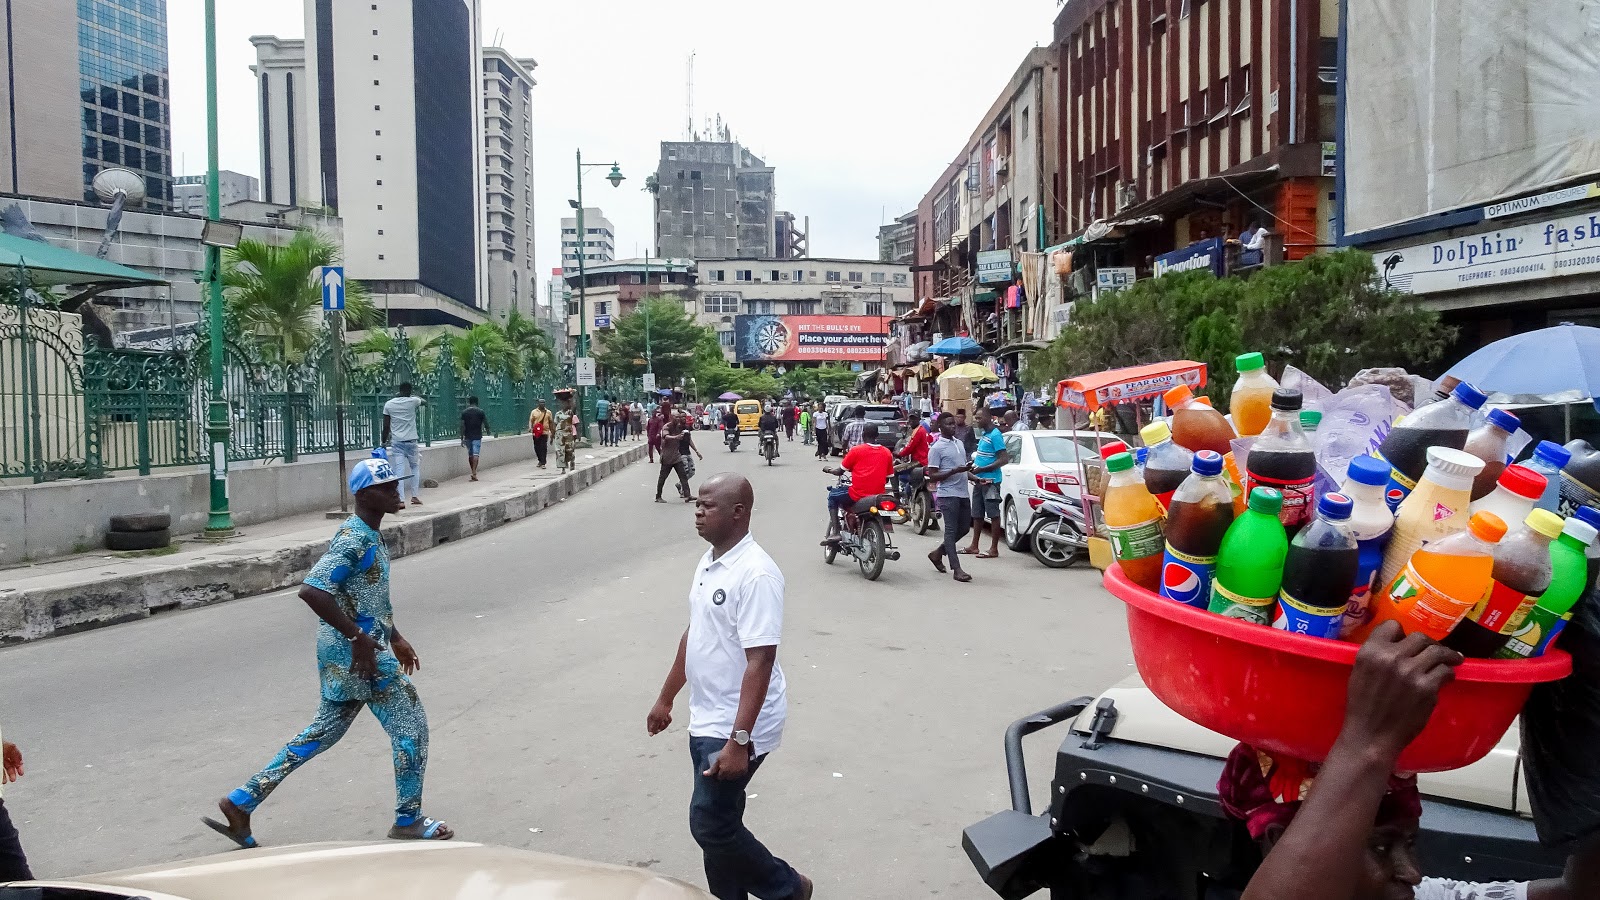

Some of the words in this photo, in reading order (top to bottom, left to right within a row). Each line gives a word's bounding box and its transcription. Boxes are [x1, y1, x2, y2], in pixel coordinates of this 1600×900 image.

[1488, 197, 1540, 216] OPTIMUM
[1541, 186, 1587, 203] EXPOSURES
[1432, 233, 1518, 265] Dolphin
[799, 334, 822, 343] Place
[823, 336, 842, 345] your
[843, 335, 869, 343] advert
[1125, 380, 1150, 389] FEAR
[1152, 375, 1173, 384] GOD
